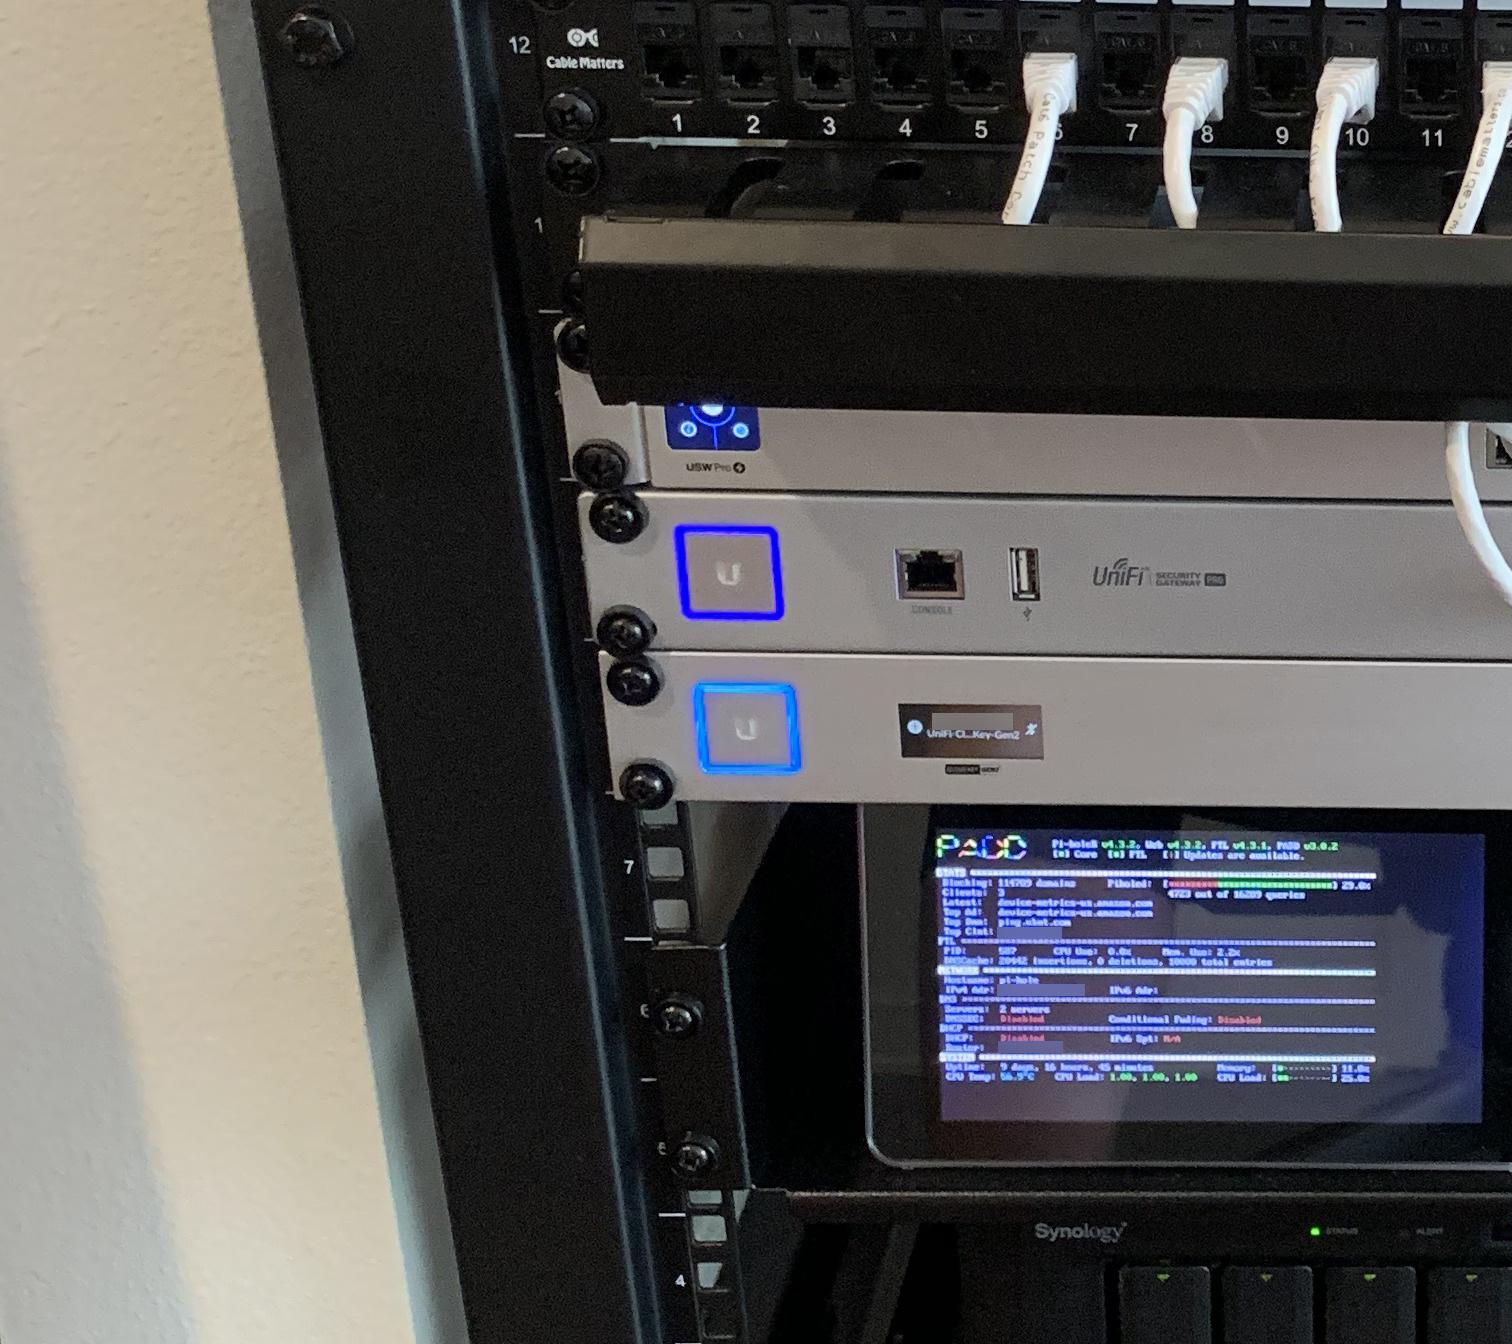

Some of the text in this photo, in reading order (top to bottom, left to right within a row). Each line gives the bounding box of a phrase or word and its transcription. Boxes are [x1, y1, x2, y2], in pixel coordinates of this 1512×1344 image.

[508, 35, 531, 54] 12
[546, 56, 625, 70] Cable Matters
[672, 113, 682, 132] 1
[746, 114, 761, 134] 2
[822, 116, 836, 136] 3
[899, 118, 913, 137] 4
[975, 120, 988, 139] 5
[1126, 123, 1139, 142] 7
[1201, 123, 1214, 144] 8
[1275, 126, 1289, 145] 9
[1345, 127, 1369, 146] 10
[1422, 129, 1442, 147] 11
[686, 462, 732, 472] USW Pro
[1093, 565, 1144, 587] UniFi
[1155, 572, 1201, 580] SECURITY
[911, 605, 953, 614] CONSOLE
[1184, 852, 1223, 860] Updates
[624, 859, 634, 875] 7
[1034, 1222, 1123, 1244] Synology
[675, 1274, 686, 1287] 4
